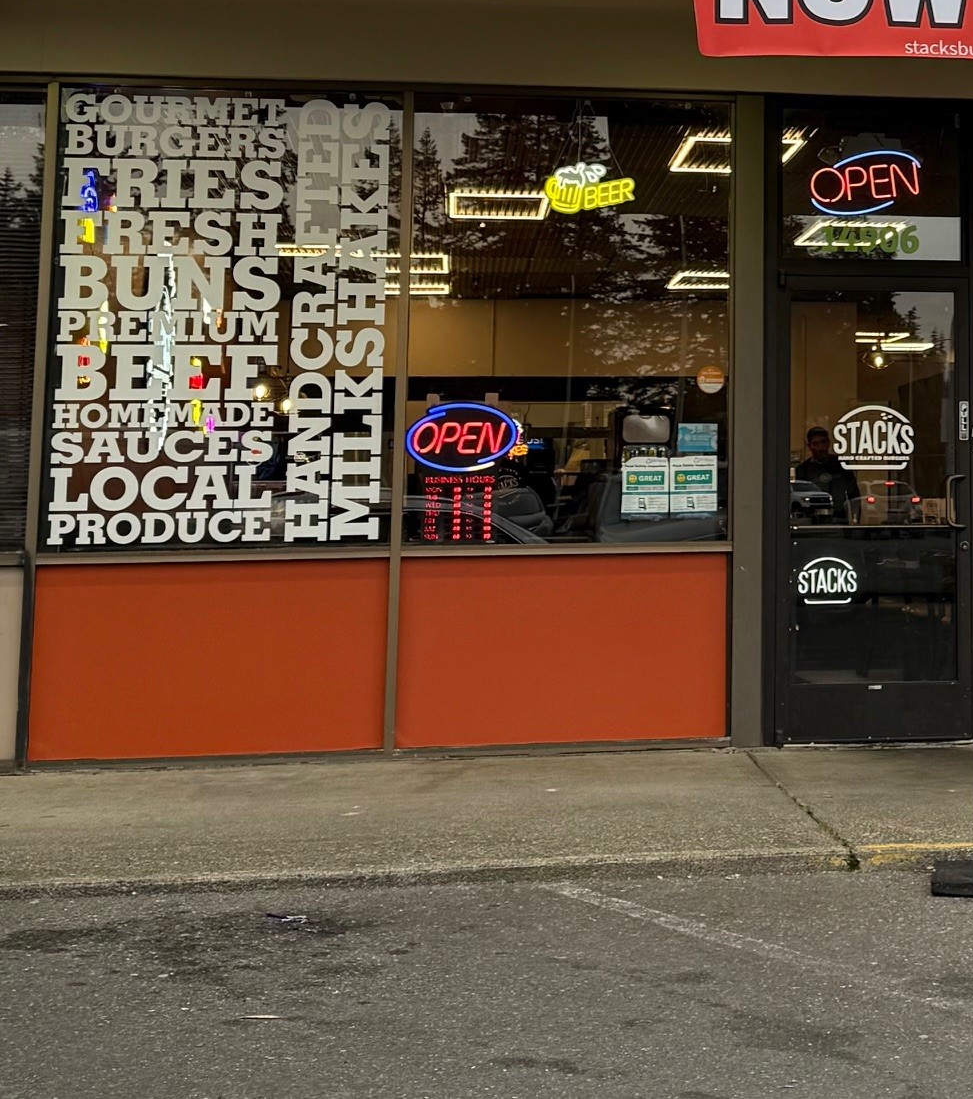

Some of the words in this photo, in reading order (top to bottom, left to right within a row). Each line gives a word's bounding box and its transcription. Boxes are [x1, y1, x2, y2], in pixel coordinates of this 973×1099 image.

[65, 93, 286, 126] GOURMET
[65, 124, 287, 159] BURGERS
[61, 158, 284, 211] FRIES
[583, 179, 636, 210] BEER
[811, 162, 920, 203] OPEN
[59, 210, 282, 255] FRESH
[821, 225, 920, 255] 14906
[57, 254, 281, 311] BUNS
[56, 310, 279, 343] PREMIUM
[284, 99, 340, 542] HANDCRAFTED
[330, 100, 391, 541] MILKSHAKES
[54, 344, 278, 401] BEEF
[52, 402, 274, 429] HOMEMADE
[50, 429, 273, 465] SAUCES
[412, 421, 508, 454] OPEN
[833, 420, 915, 455] STACKS
[48, 465, 272, 512] LOCAL
[425, 476, 463, 484] BUSINESS
[465, 475, 496, 483] HOURS
[686, 473, 711, 481] GREAT
[46, 511, 271, 546] PRODUCE
[798, 568, 857, 594] STACKS
